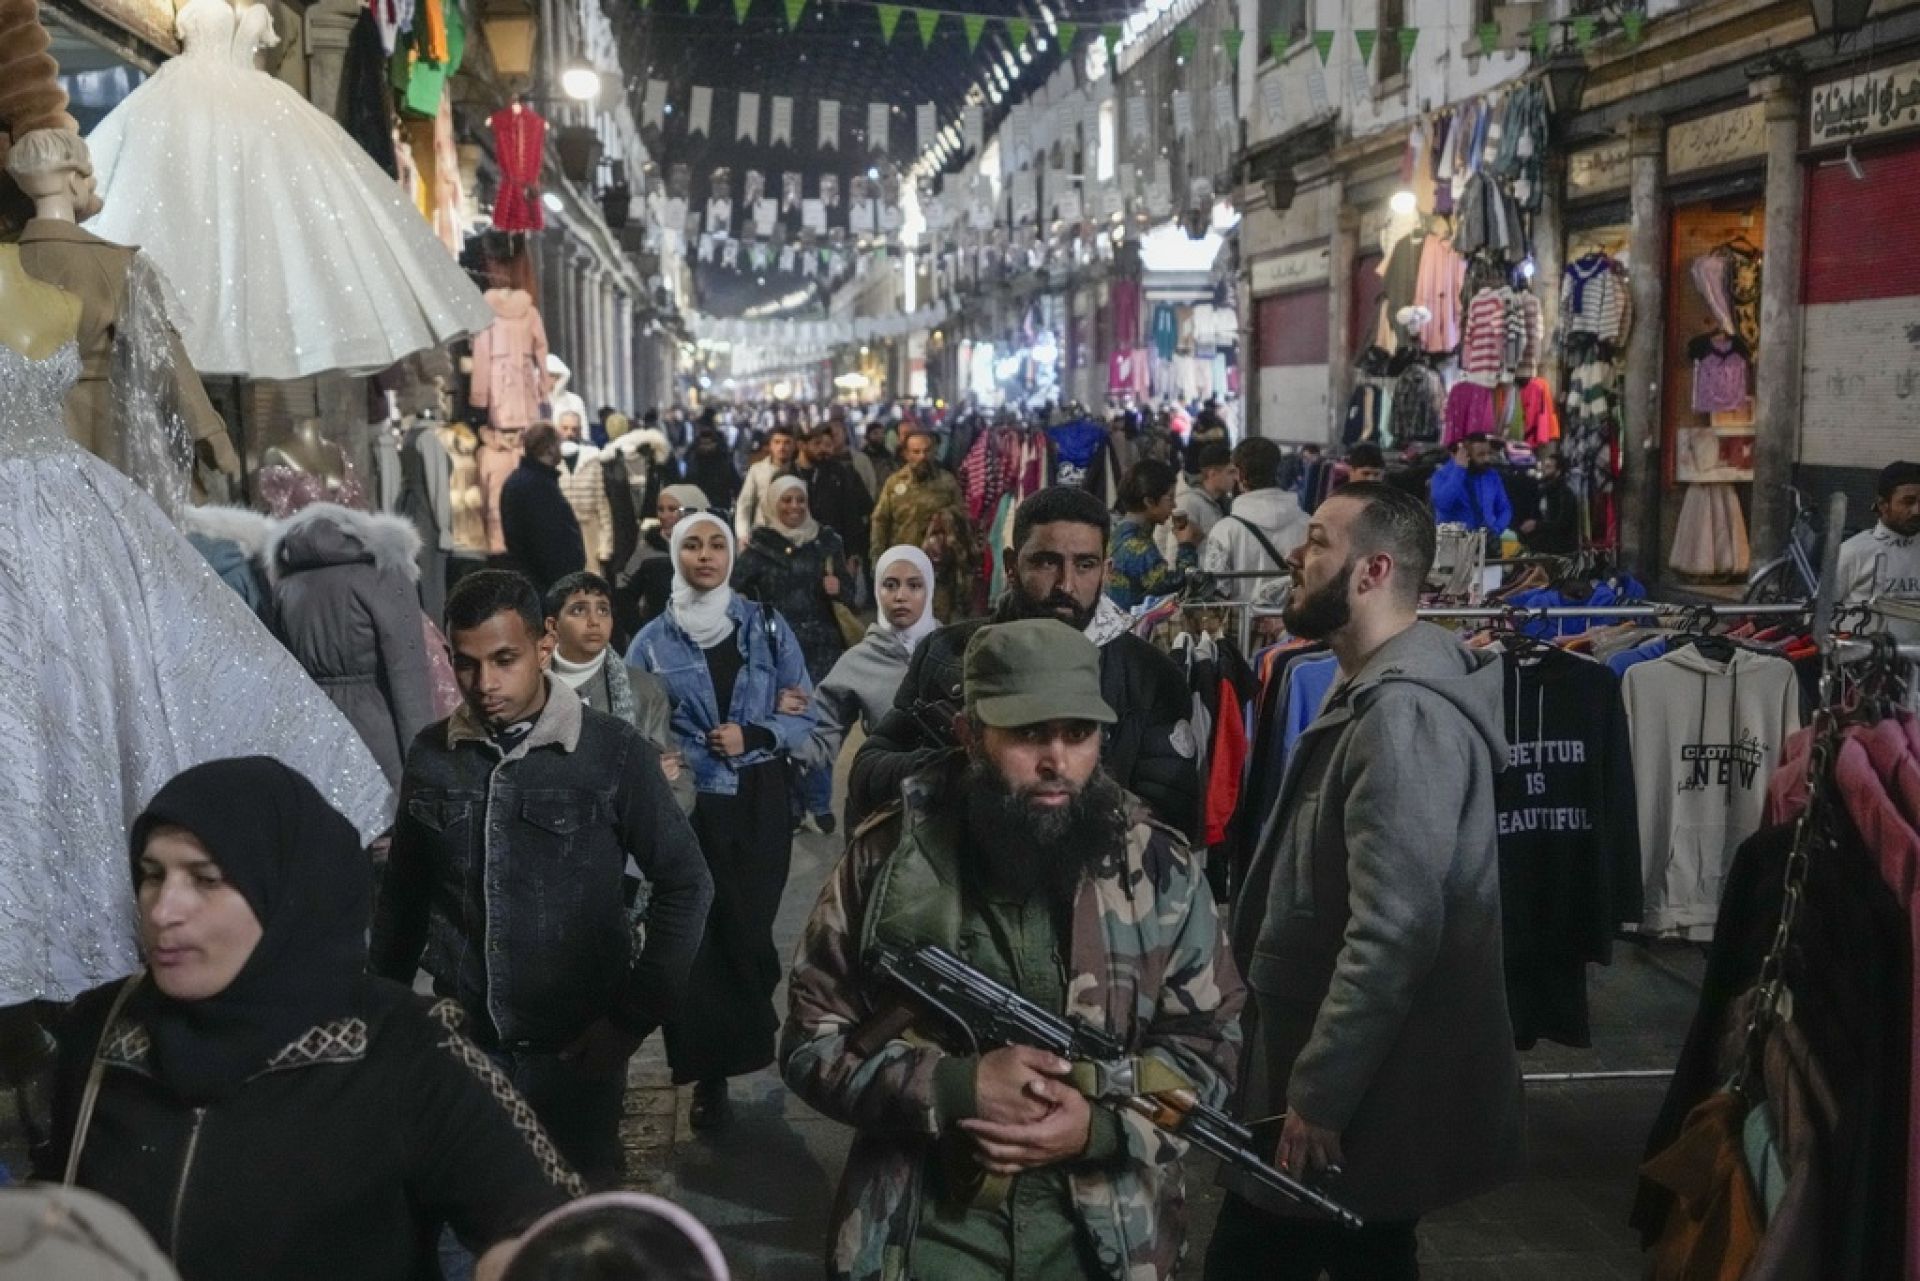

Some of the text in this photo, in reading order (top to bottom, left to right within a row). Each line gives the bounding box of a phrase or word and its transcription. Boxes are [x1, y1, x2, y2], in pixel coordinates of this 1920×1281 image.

[1884, 576, 1920, 593] ZAR
[1526, 772, 1546, 795] IS
[1694, 758, 1757, 790] NEW
[1497, 808, 1593, 834] EAUTIFUL
